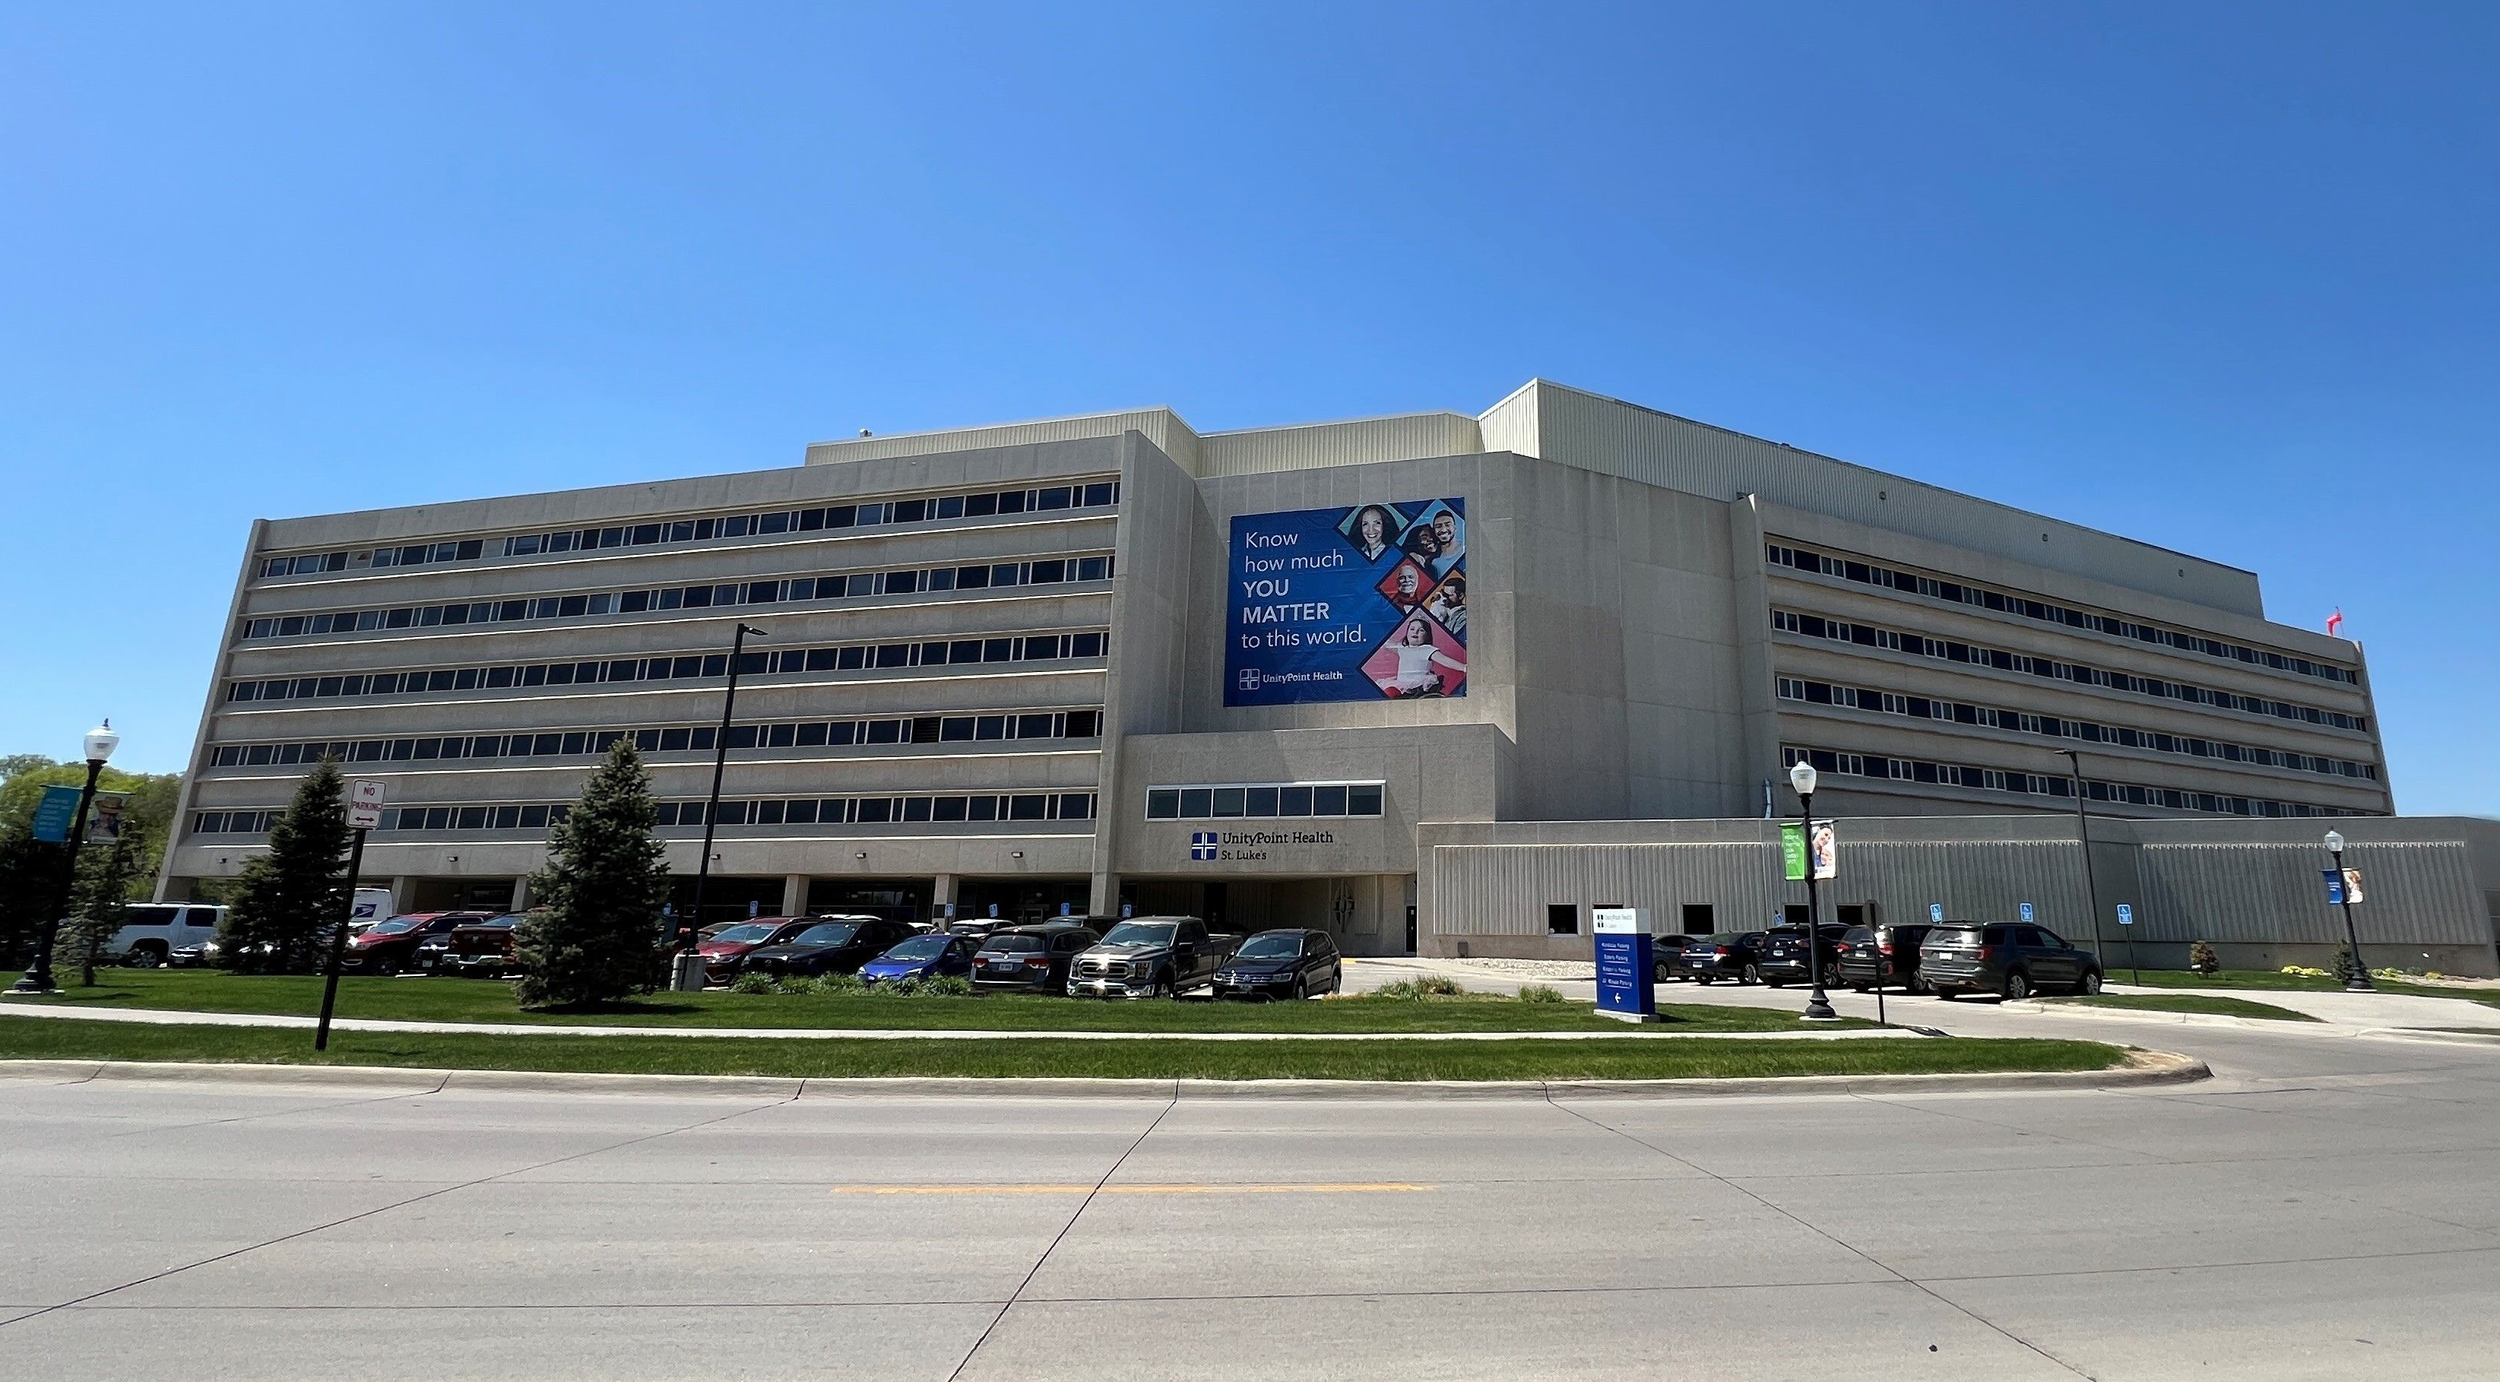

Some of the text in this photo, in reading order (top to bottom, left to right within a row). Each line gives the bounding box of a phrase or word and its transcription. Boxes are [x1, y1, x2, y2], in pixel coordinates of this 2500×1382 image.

[1246, 532, 1298, 549] Know
[1245, 549, 1343, 573] how much
[1243, 578, 1290, 598] YOU
[1243, 602, 1330, 624] MATTER
[1241, 624, 1367, 649] to this world.
[1262, 671, 1343, 684] UnityPoint Health
[363, 786, 376, 797] NO
[350, 800, 382, 812] PARKING
[1222, 831, 1334, 846] UnityPoint Health
[1221, 850, 1267, 861] St. Luke's
